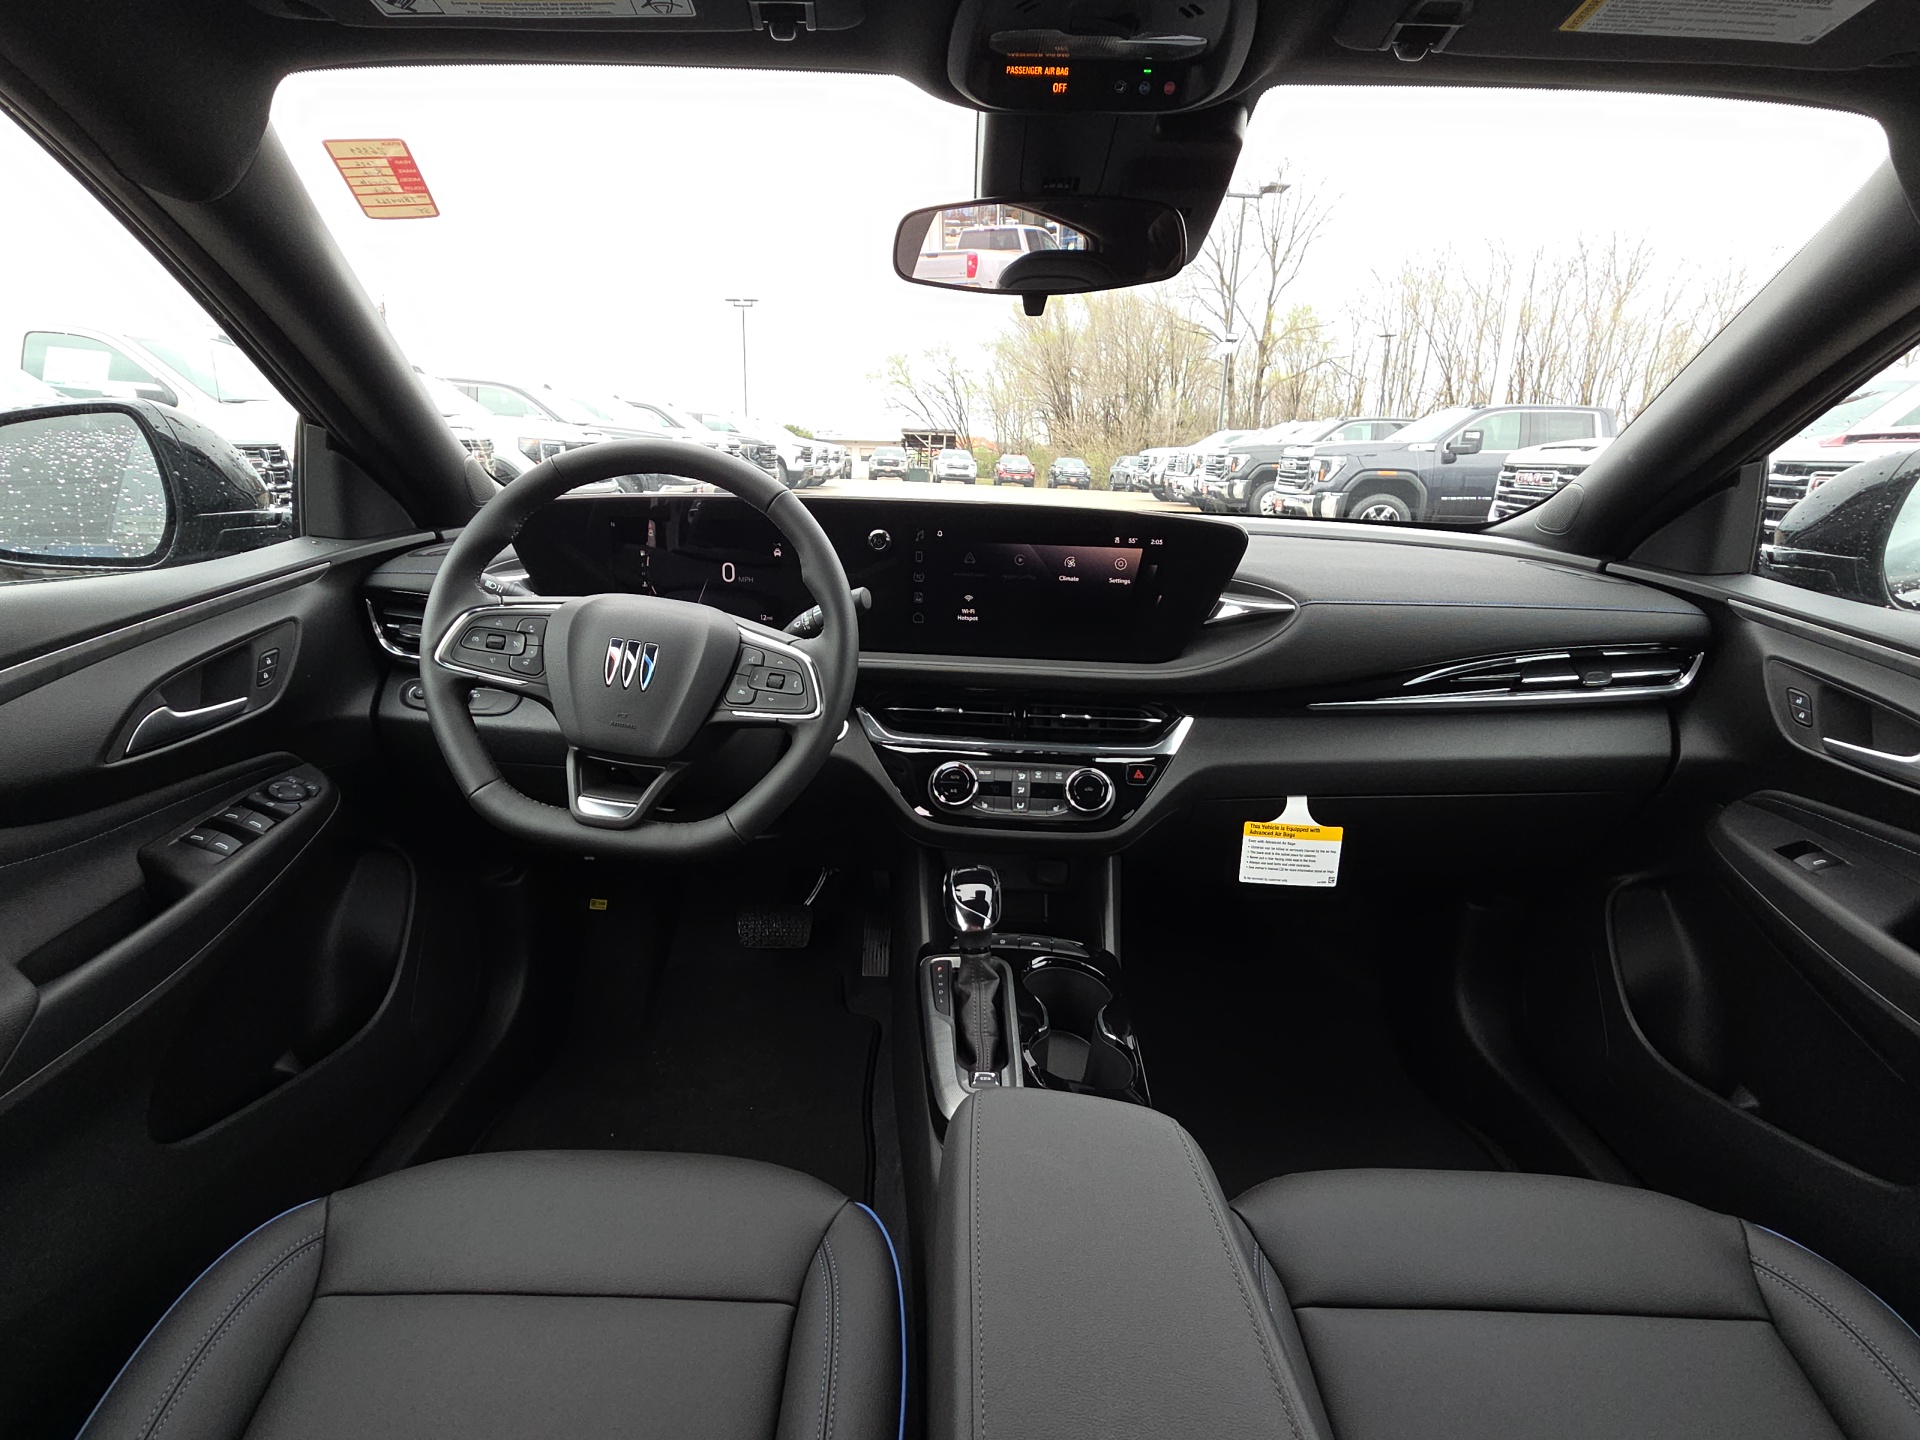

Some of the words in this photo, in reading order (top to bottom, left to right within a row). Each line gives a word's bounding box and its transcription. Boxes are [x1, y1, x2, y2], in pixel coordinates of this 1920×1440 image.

[1006, 65, 1043, 75] PASSENGER
[1044, 66, 1056, 75] AIR
[1055, 66, 1069, 76] BAG
[1052, 82, 1068, 93] OFF
[1517, 472, 1553, 486] GMC
[722, 562, 736, 583] 0
[1108, 577, 1131, 585] Settings
[957, 614, 979, 622] Hotspot
